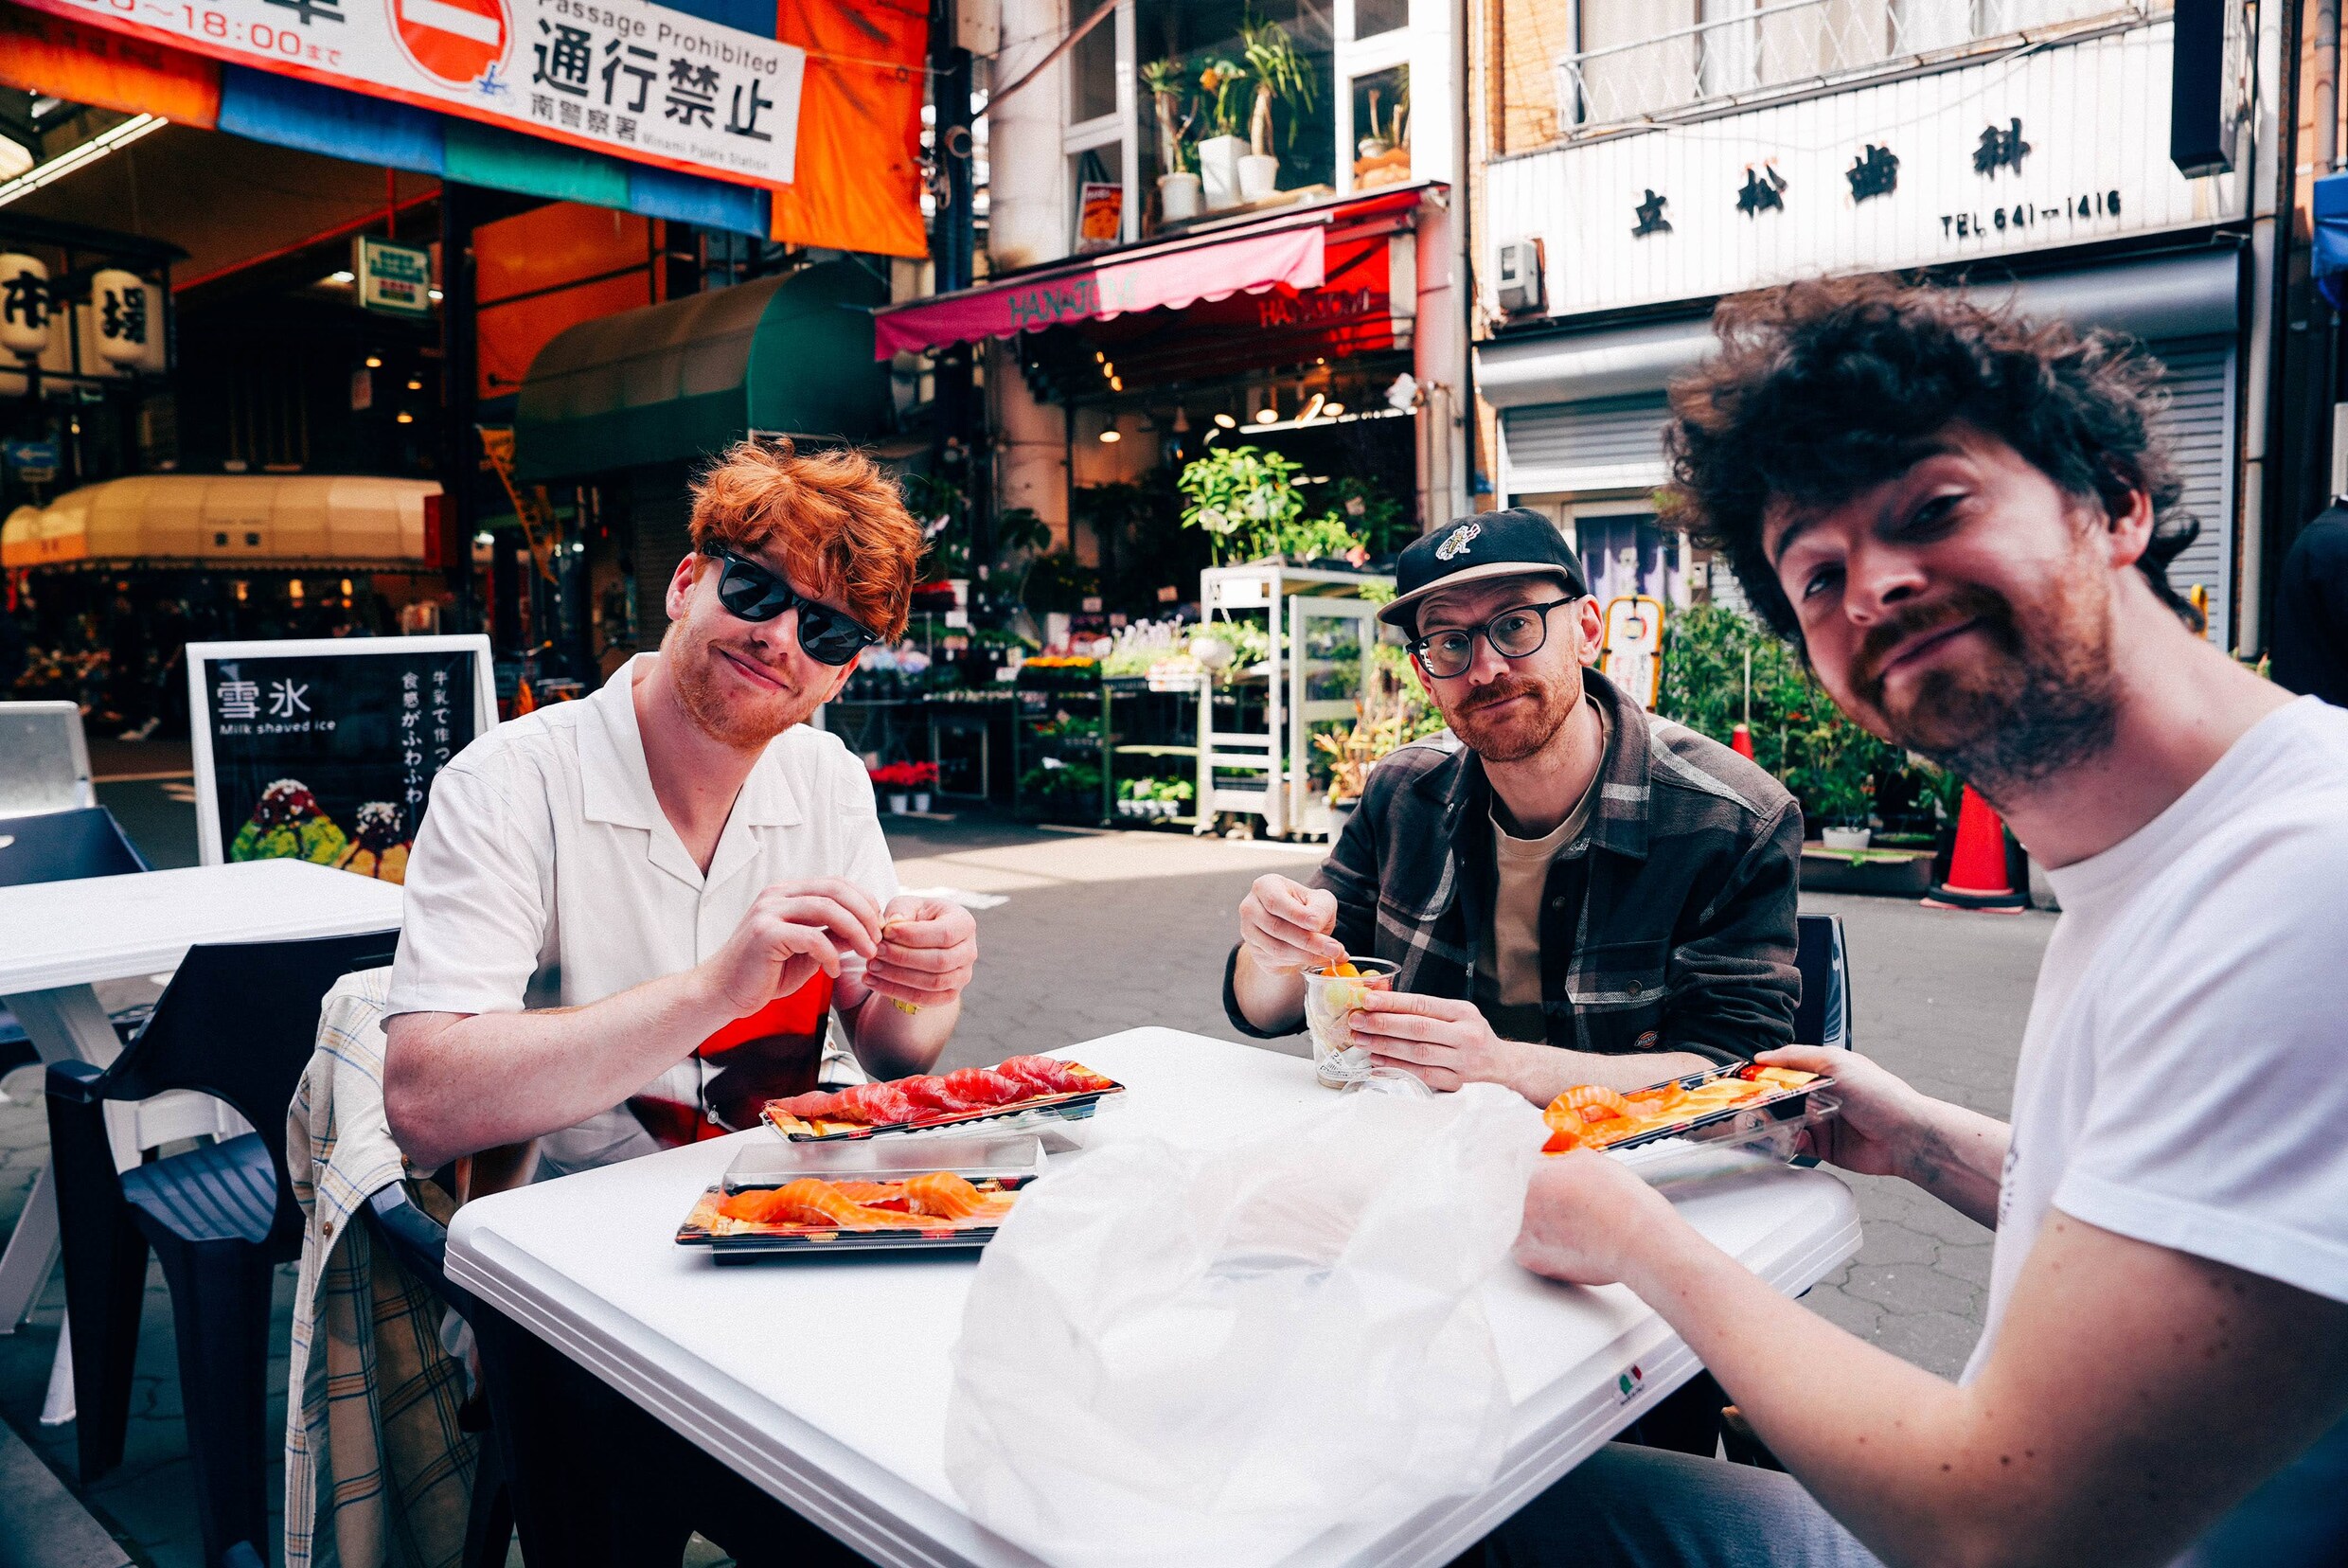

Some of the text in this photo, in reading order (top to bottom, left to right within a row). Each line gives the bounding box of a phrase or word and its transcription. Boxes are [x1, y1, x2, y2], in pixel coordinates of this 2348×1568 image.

[539, 0, 778, 75] assage Prohibited
[533, 19, 774, 141] 通行禁止
[531, 95, 637, 142] 南警察署
[217, 679, 311, 719] 雪氷
[220, 721, 336, 735] Milk shaved ice
[401, 671, 423, 804] 食感がふわふわ
